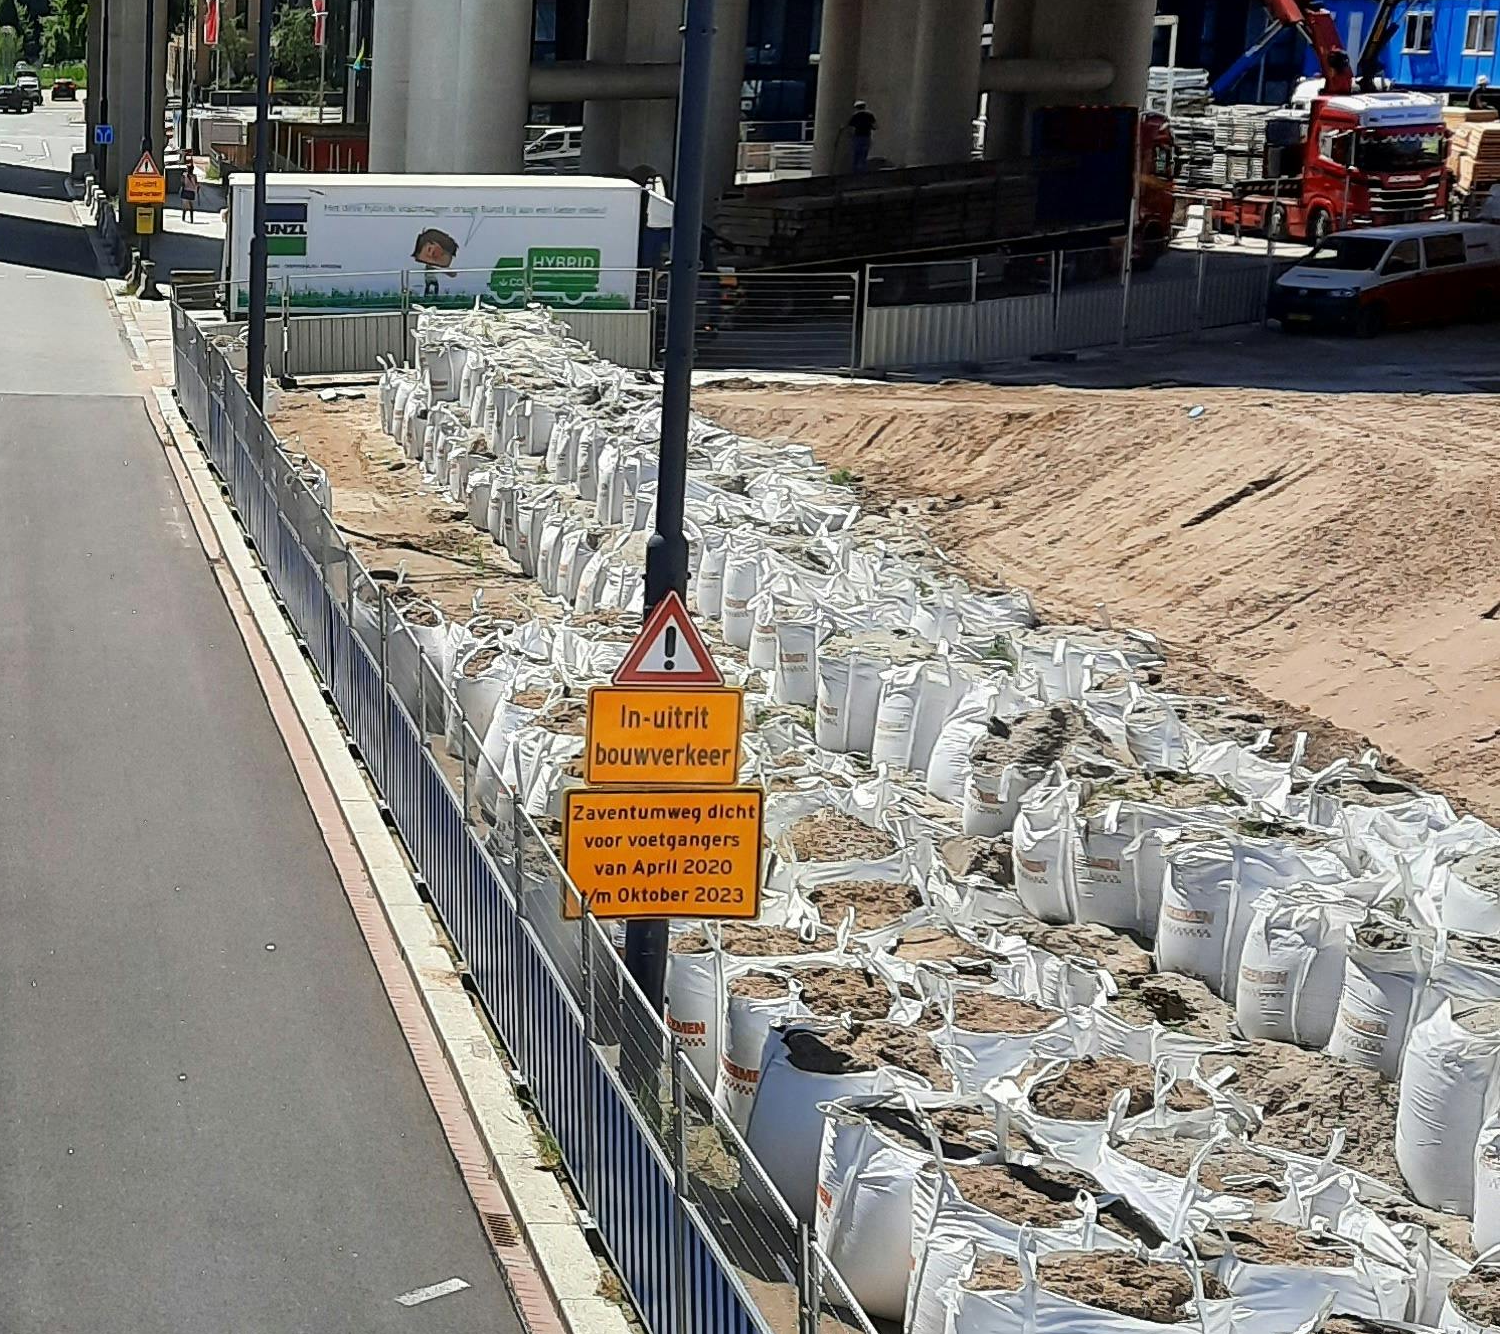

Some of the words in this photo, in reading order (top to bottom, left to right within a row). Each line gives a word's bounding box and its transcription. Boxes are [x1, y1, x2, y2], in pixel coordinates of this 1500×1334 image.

[265, 224, 308, 235] UNZL
[532, 255, 595, 269] HYBRID
[621, 704, 709, 729] In-uitrit
[595, 742, 732, 766] bouwverkeer
[707, 804, 757, 820] dicht
[584, 835, 623, 848] voor
[628, 833, 741, 851] voetgangers
[594, 862, 627, 876] van
[632, 859, 678, 877] April
[683, 858, 733, 875] 2020
[618, 887, 689, 903] Oktober
[694, 887, 744, 903] 2023
